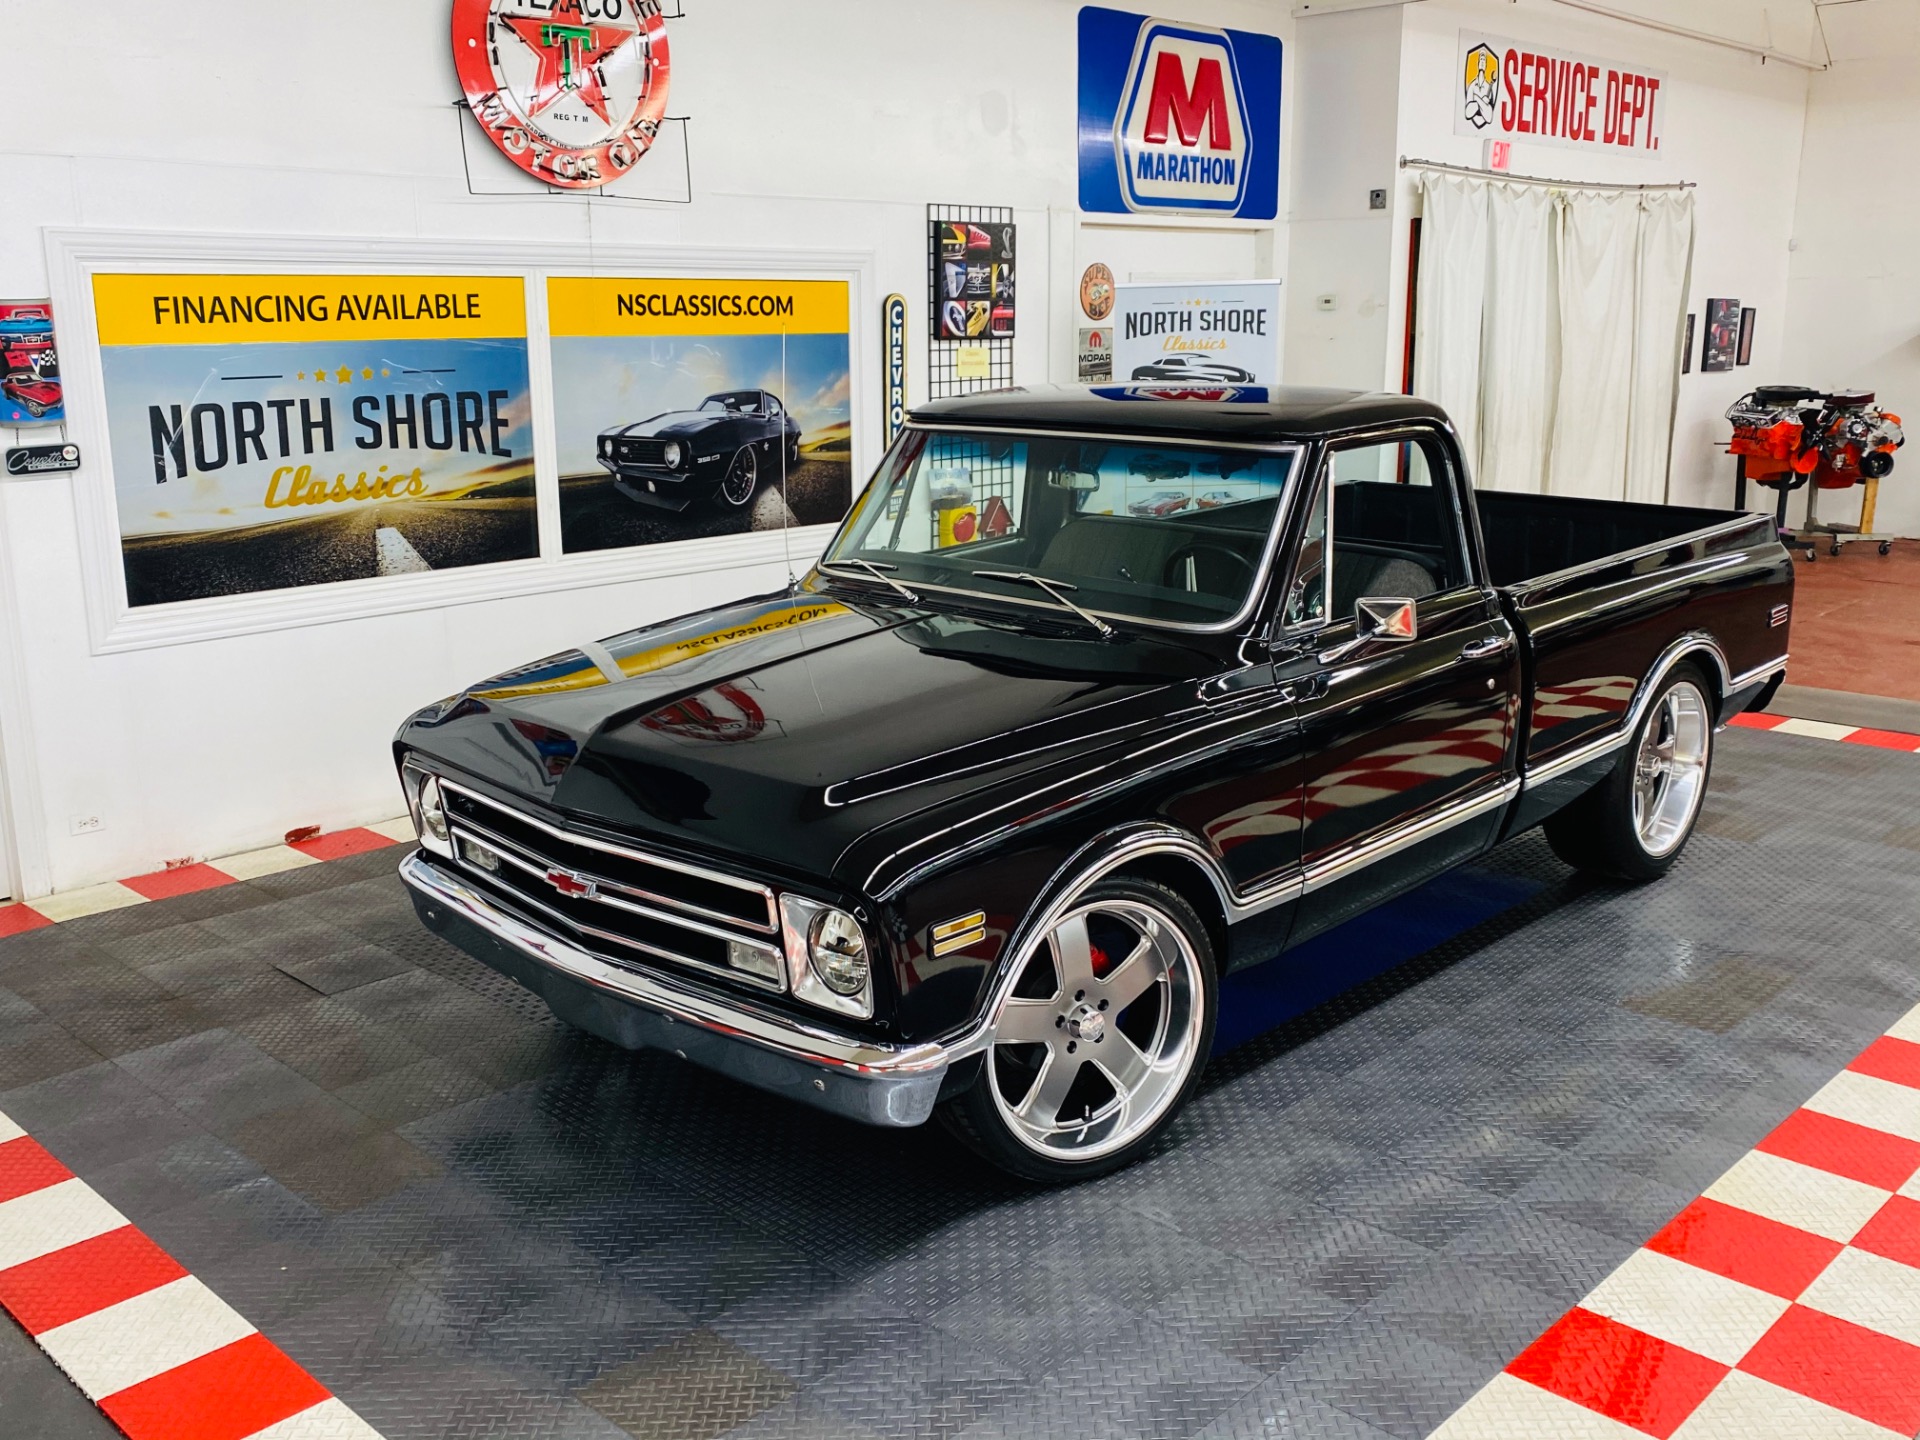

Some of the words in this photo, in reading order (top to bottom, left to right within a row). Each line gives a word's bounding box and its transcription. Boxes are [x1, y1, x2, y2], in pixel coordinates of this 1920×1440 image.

[1144, 51, 1231, 151] M
[1501, 48, 1599, 141] SERVICE
[1603, 70, 1660, 150] DEPT.
[553, 113, 570, 121] REG
[480, 93, 601, 183] MOTOR
[1137, 151, 1235, 185] MARATHON
[1491, 141, 1511, 169] EXIT
[153, 295, 328, 324] FINANCING
[336, 293, 481, 321] AVAILABLE
[617, 294, 794, 316] NSCLASSICS.COM
[1089, 296, 1111, 317] BEE
[1125, 310, 1192, 340] NORTH
[1200, 309, 1267, 336] SHORE
[1079, 353, 1111, 363] MOPAR
[1163, 335, 1228, 351] Classics
[149, 397, 334, 484] NORTH
[353, 389, 512, 458] SHORE
[8, 450, 64, 471] Corvette
[264, 465, 428, 509] Classics
